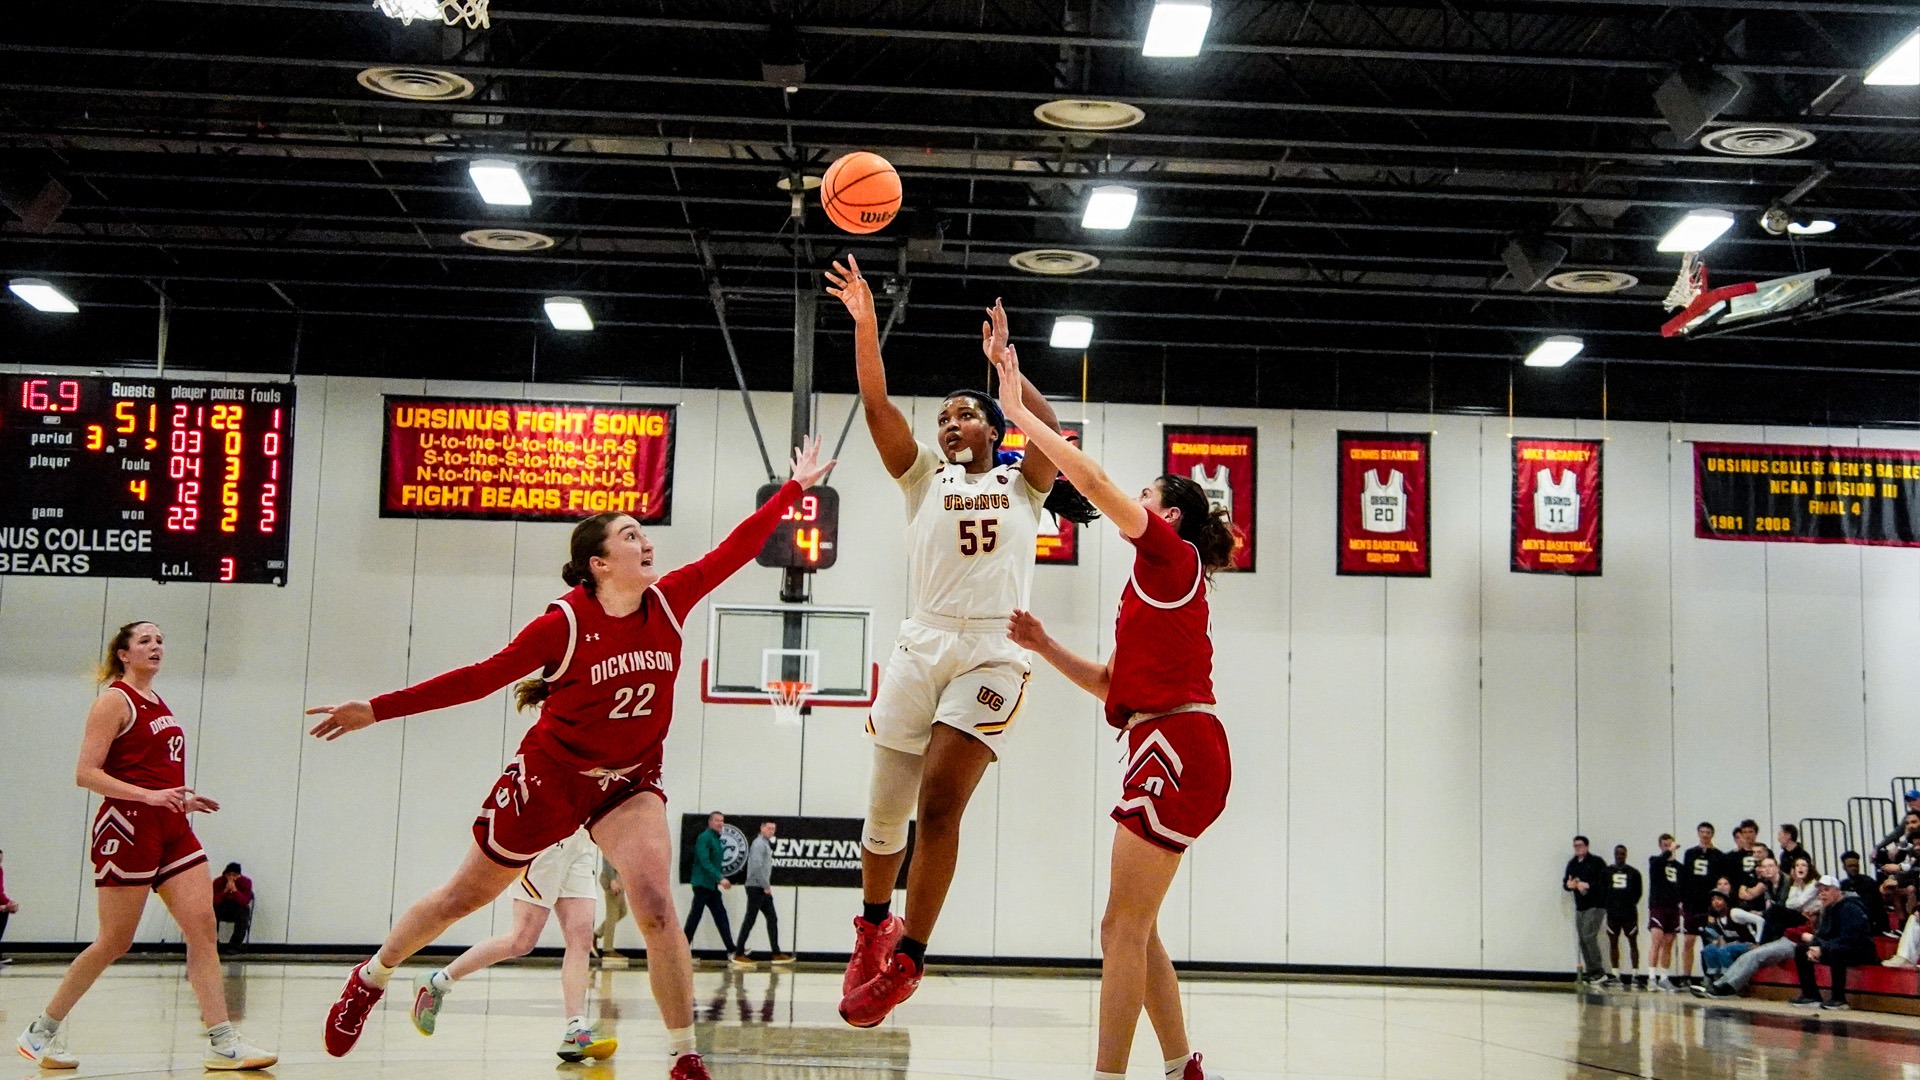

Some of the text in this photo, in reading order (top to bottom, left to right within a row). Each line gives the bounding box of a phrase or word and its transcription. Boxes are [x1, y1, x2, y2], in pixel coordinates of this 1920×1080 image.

[111, 381, 155, 398] Guests
[171, 385, 281, 403] player points fouls
[211, 405, 242, 429] 22
[396, 407, 664, 437] URSINUS FIGHT SONG
[31, 432, 73, 445] period
[86, 425, 102, 449] 3
[171, 430, 278, 455] 03 0 0
[30, 454, 71, 469] player
[121, 457, 150, 470] fouls
[170, 456, 200, 478] 04
[225, 456, 240, 480] 3
[1707, 457, 1769, 473] URSINUS
[1770, 460, 1825, 475] COLLEGE
[1828, 461, 1873, 477] MEN'S
[129, 480, 146, 500] 4
[178, 482, 276, 506] 12 6 2
[1770, 479, 1898, 498] NCAA DIVISION III
[401, 485, 649, 513] FIGHT BEARS FIGHT!
[944, 494, 1010, 511] URSINUS
[1808, 499, 1861, 516] FINAL 4
[31, 507, 64, 520] game
[121, 510, 145, 520] won
[167, 507, 275, 532] 22 2 2
[1374, 508, 1394, 521] 20
[1549, 508, 1564, 522] 11
[44, 528, 152, 552] COLLEGE
[796, 528, 819, 562] 4
[958, 518, 999, 557] 55
[0, 553, 90, 574] BEARS
[220, 558, 234, 580] 3
[590, 650, 673, 685] DICKINSON
[608, 683, 656, 719] 22
[976, 685, 1004, 712] UC
[167, 735, 184, 762] 12
[1665, 866, 1677, 882] S
[1693, 858, 1708, 876] S
[1743, 856, 1755, 872] S
[1612, 873, 1627, 889] S
